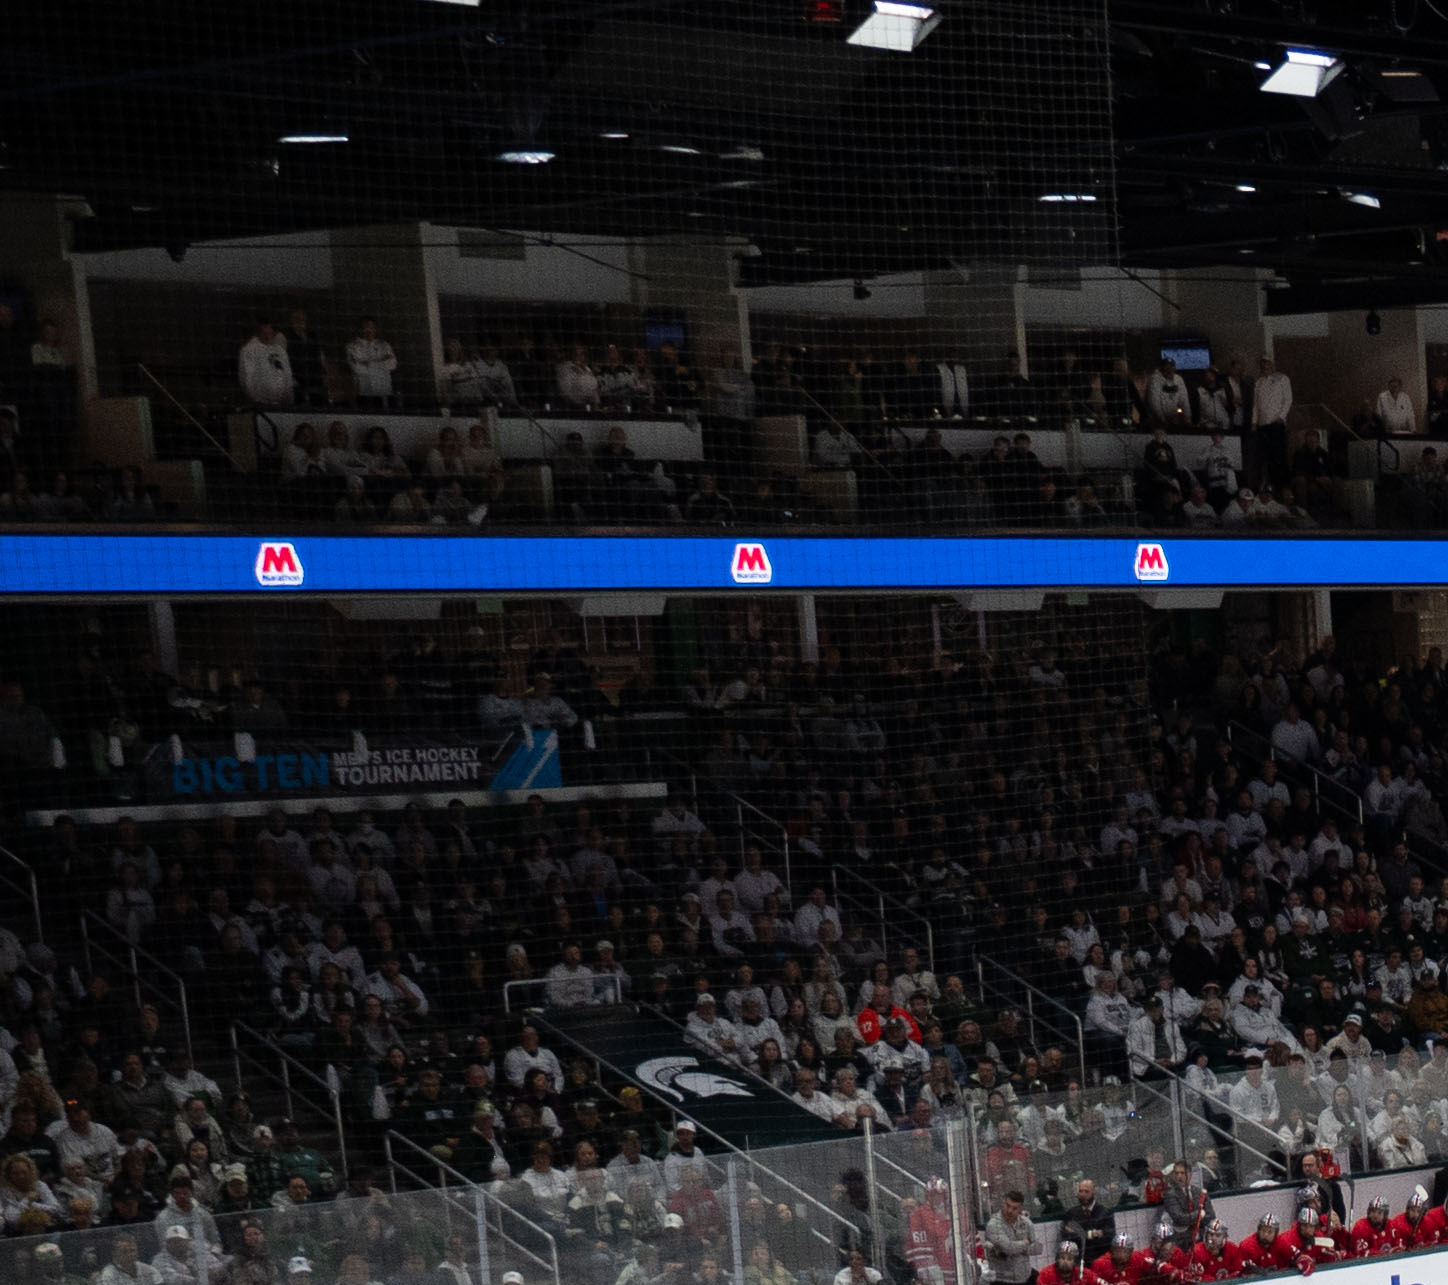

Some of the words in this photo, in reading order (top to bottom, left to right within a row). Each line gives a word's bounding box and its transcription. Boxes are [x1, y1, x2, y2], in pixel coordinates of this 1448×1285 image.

[262, 546, 297, 572] M
[737, 546, 768, 571] M
[1139, 547, 1166, 570] M
[386, 749, 412, 764] ICE
[415, 747, 479, 764] HOCKEY
[171, 755, 245, 794] BIG
[252, 753, 331, 789] TEN
[335, 762, 482, 786] TOURNAMENT
